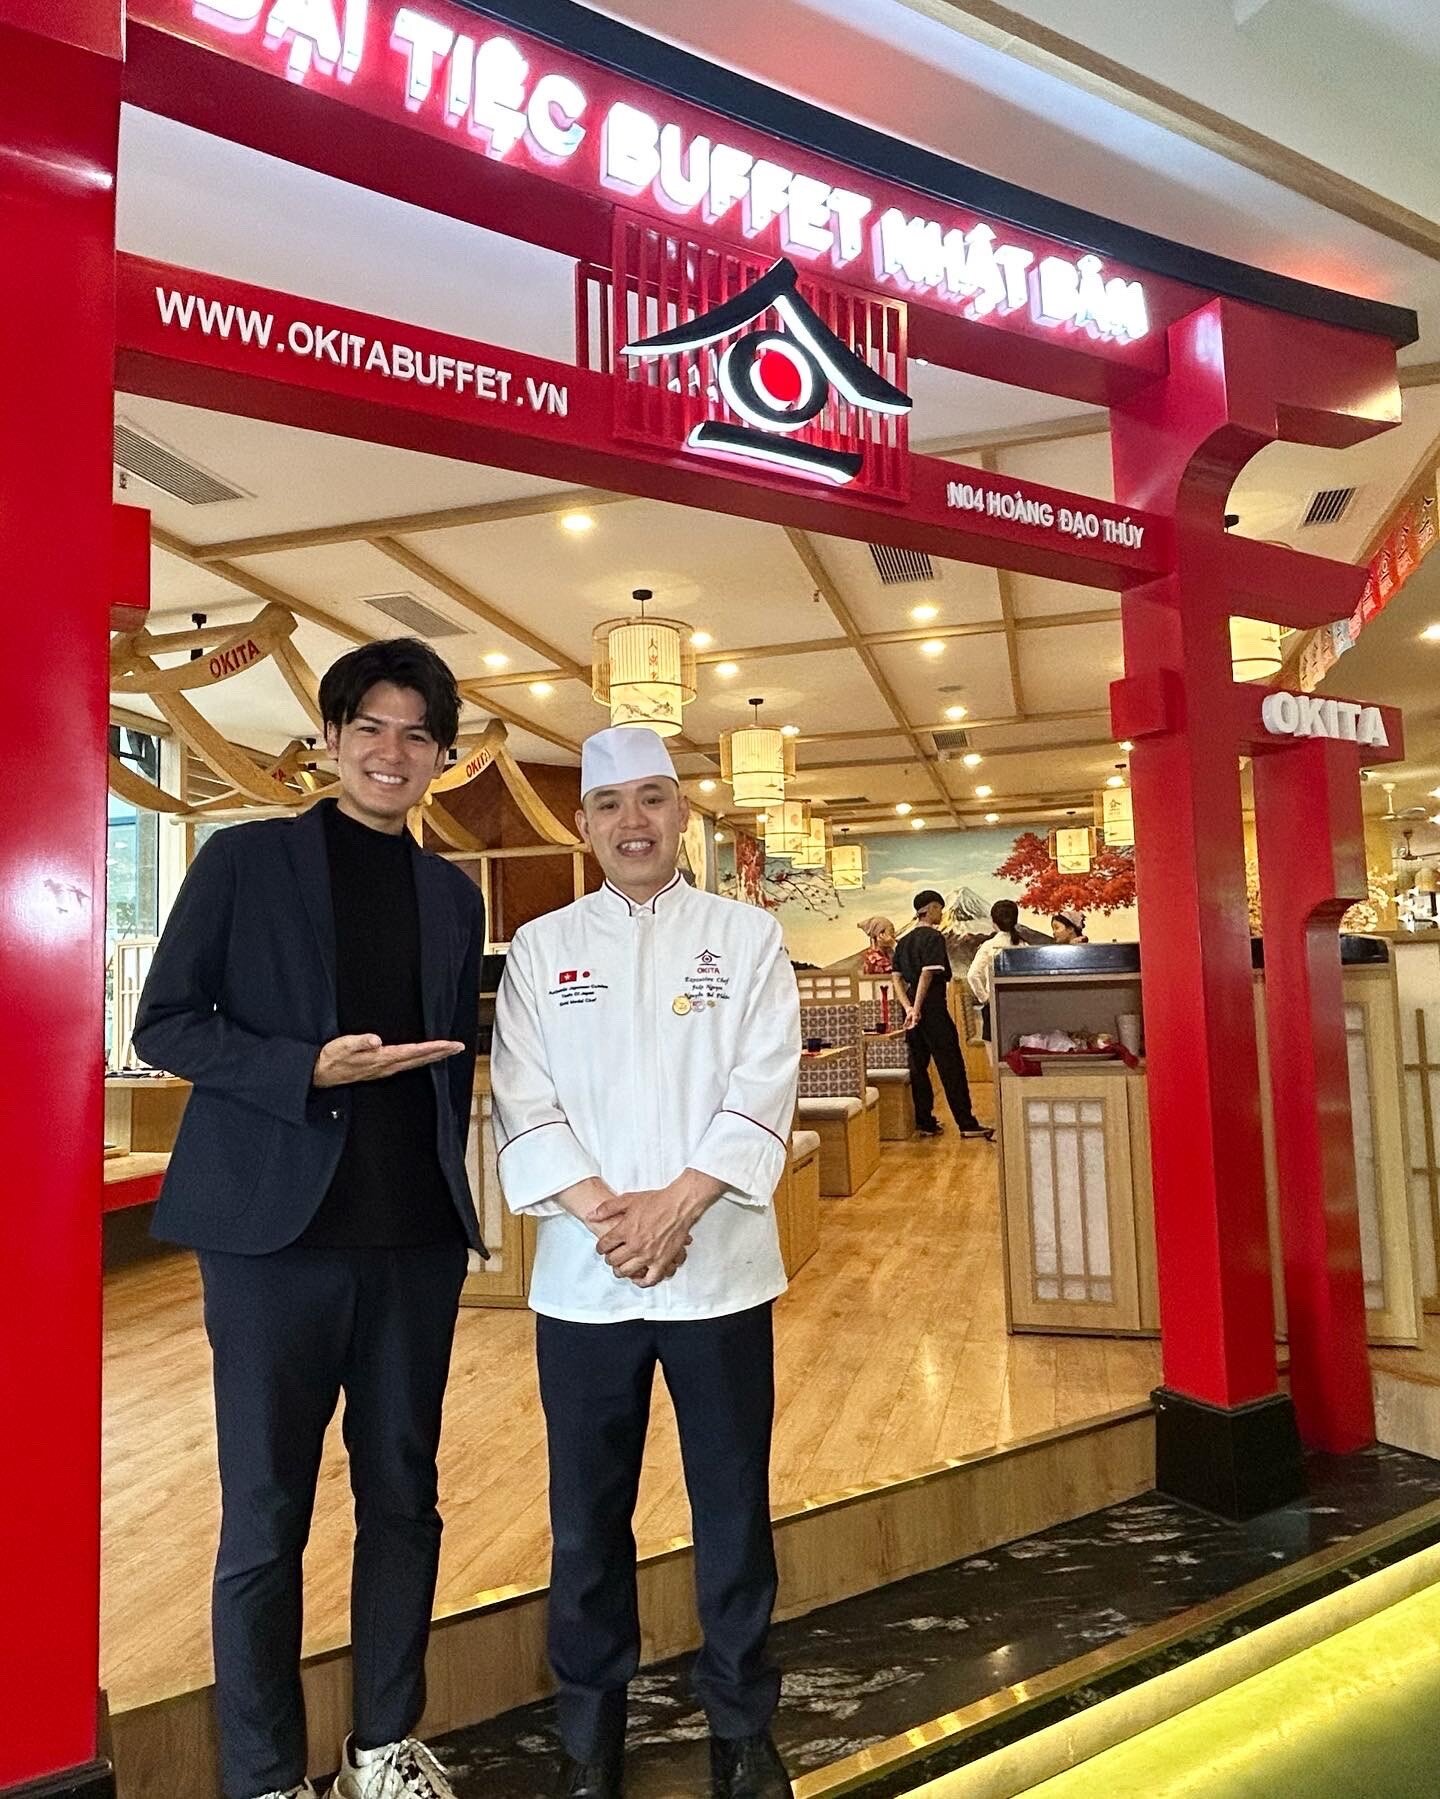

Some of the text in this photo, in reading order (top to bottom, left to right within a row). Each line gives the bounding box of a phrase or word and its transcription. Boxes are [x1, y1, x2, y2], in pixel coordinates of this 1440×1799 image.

[191, 0, 370, 86] ẠI
[600, 101, 872, 268] BUFFET
[155, 286, 569, 417] WWW.OKITABUFFET.VN
[1058, 508, 1099, 539] ĐẠO
[209, 639, 260, 678] OKITA
[1262, 691, 1390, 748] OKITA
